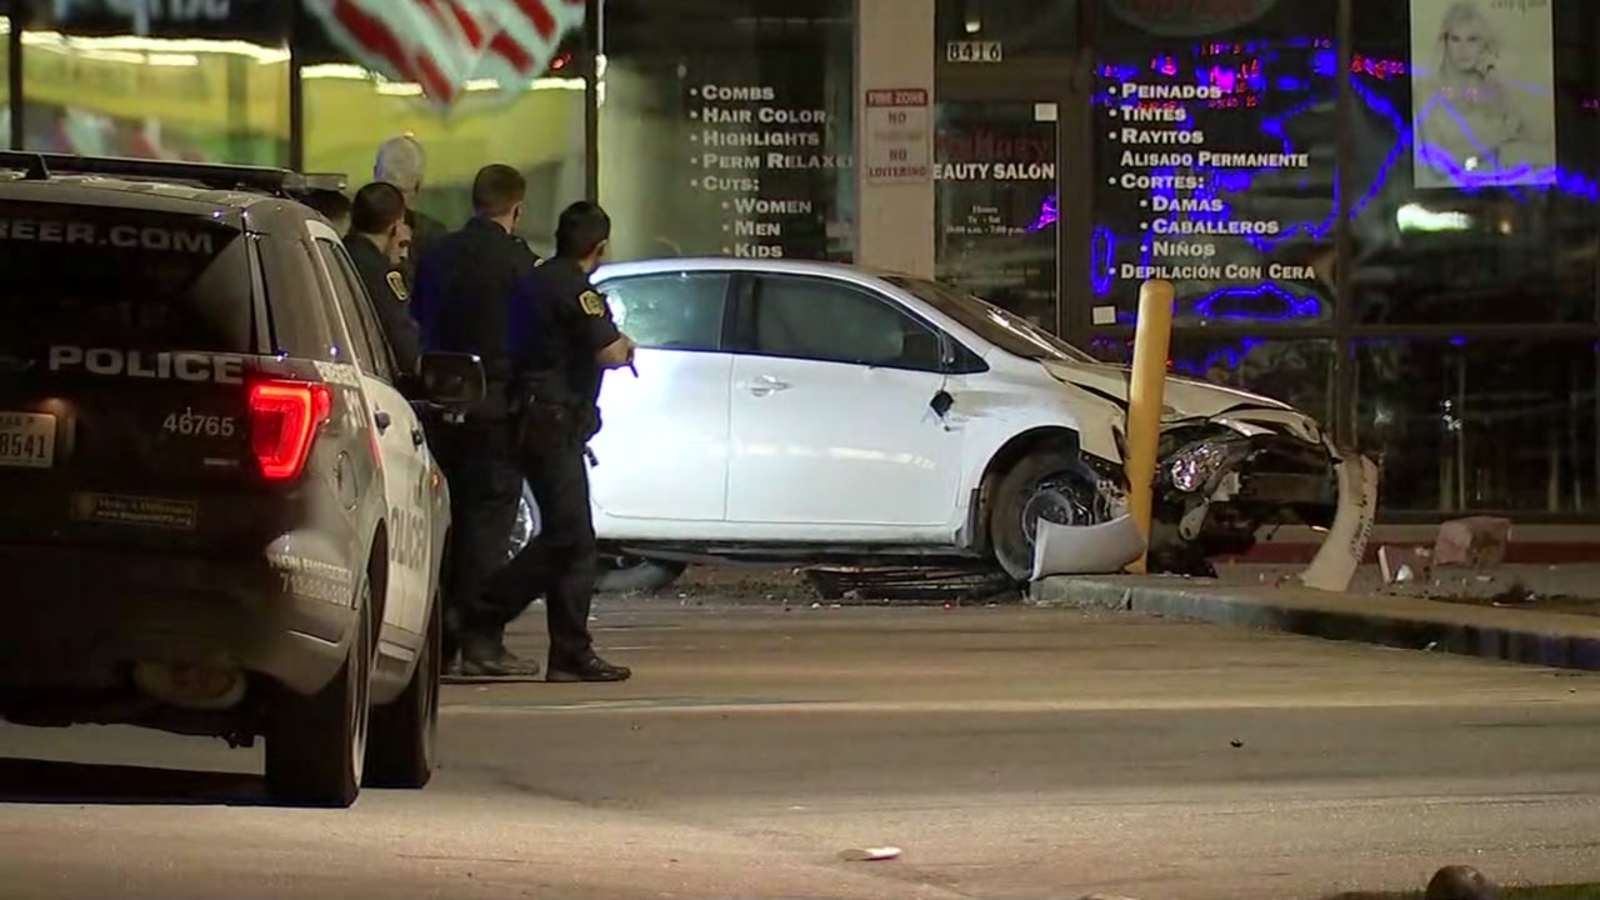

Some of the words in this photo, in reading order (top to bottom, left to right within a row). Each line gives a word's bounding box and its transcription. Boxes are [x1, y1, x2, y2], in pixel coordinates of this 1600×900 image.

[948, 43, 1002, 61] 8416
[702, 84, 775, 101] COMBS
[1122, 83, 1222, 100] PEINADOS
[703, 107, 752, 123] HAIR
[758, 107, 827, 123] COLOR
[888, 111, 907, 124] NO
[1122, 107, 1187, 122] TINTES
[704, 130, 821, 146] HIGHLIGHTS
[1121, 129, 1204, 145] RAYITOS
[704, 153, 760, 169] PERM
[889, 149, 907, 162] NO
[1120, 151, 1193, 168] ALISADO
[1197, 151, 1309, 168] PERMANENTE
[933, 163, 990, 180] EAUTY
[993, 163, 1055, 180] SALON
[1121, 173, 1204, 189] CORTES:
[734, 199, 812, 214] WOMEN
[1152, 196, 1224, 212] DAMAS
[735, 221, 781, 237] MEN
[1153, 218, 1280, 235] CABALLEROS
[735, 243, 783, 258] KIDS
[1153, 239, 1216, 257] NIÑOS
[1225, 263, 1262, 279] CON
[1269, 263, 1315, 279] CERA
[48, 345, 243, 385] POLICE
[163, 411, 235, 437] 46765
